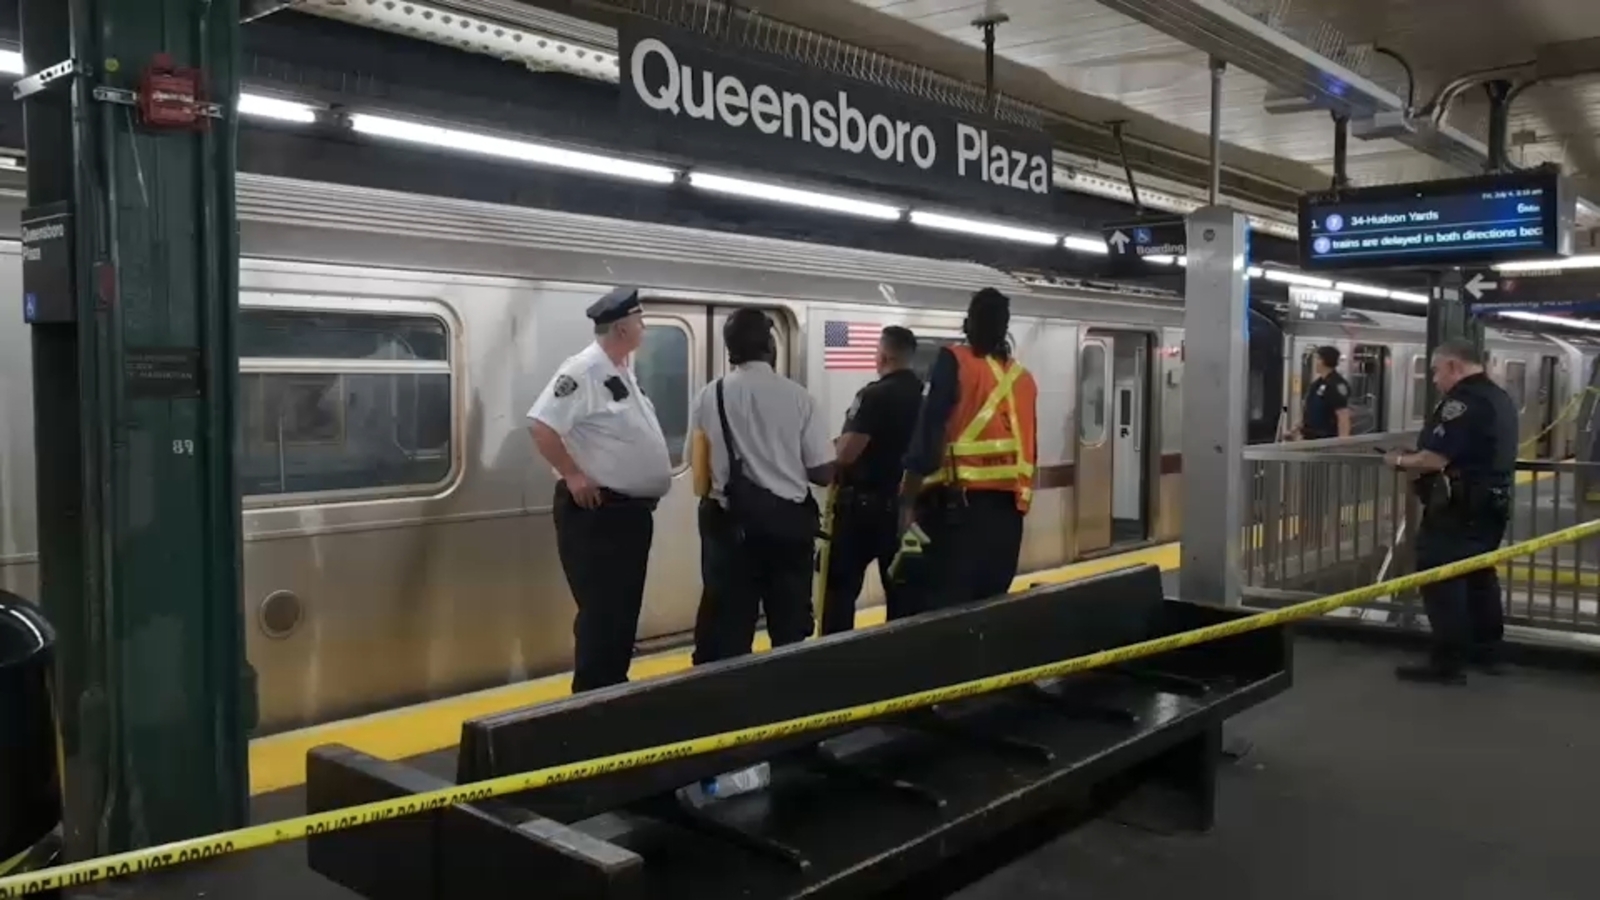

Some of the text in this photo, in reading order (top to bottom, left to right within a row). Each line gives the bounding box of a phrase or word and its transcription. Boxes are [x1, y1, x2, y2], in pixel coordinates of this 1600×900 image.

[630, 37, 1048, 195] Queensboro Plaza
[1351, 214, 1407, 226] 34-Hudson
[1409, 210, 1440, 221] Yards
[1332, 239, 1360, 249] trains
[1362, 239, 1379, 247] are
[1381, 234, 1422, 246] delayed
[1424, 233, 1434, 243] in
[1436, 231, 1460, 242] both
[1462, 228, 1517, 240] directions
